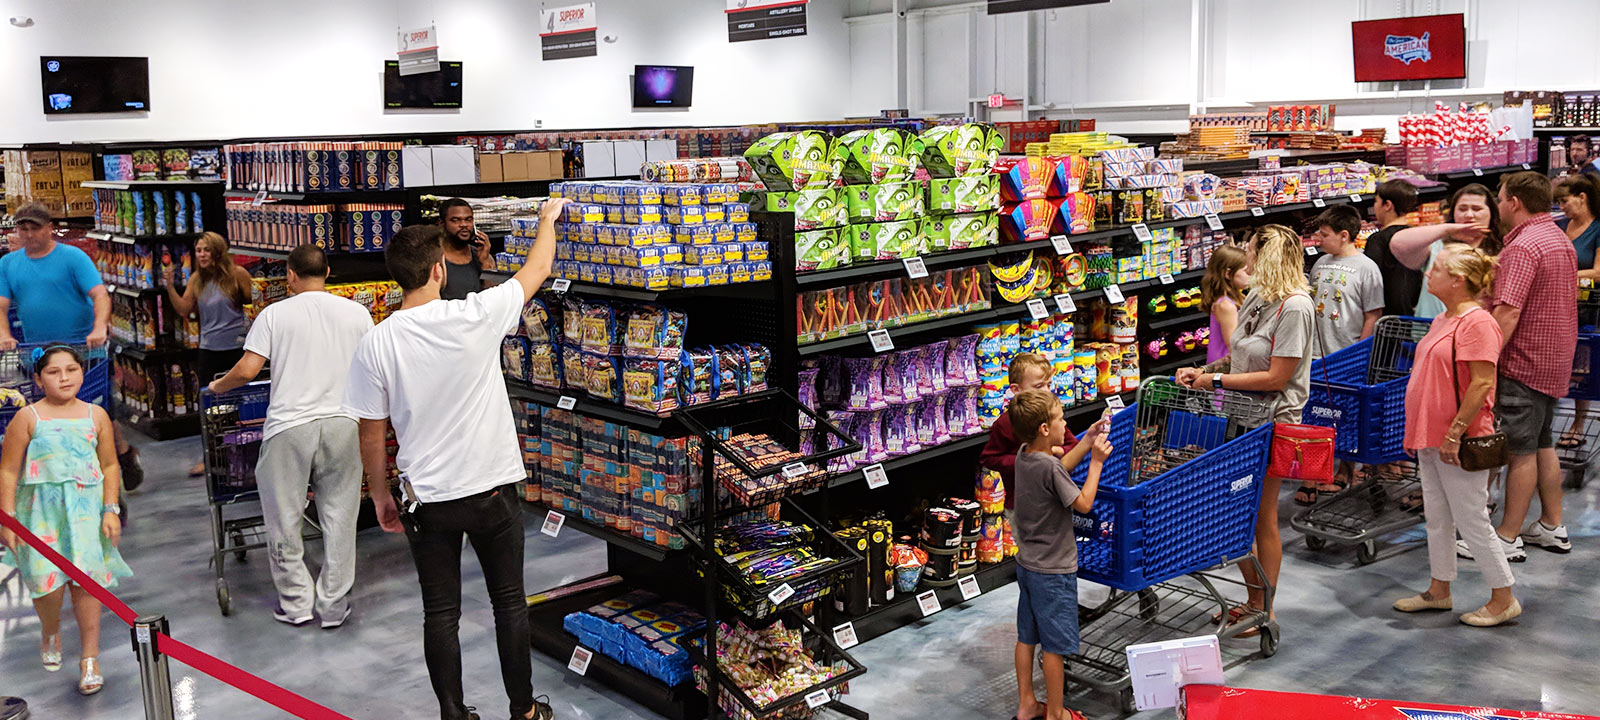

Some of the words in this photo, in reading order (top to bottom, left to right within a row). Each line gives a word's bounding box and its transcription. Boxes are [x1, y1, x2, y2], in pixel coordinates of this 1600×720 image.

[547, 12, 554, 33] 4
[559, 8, 584, 22] SUPERIOR
[403, 32, 408, 51] 5
[410, 30, 428, 42] SUPERIOR
[1385, 40, 1429, 54] AMERICAN
[868, 151, 910, 167] AMAZING
[952, 147, 989, 161] AMAZING
[789, 157, 834, 173] AMAZING
[1230, 474, 1253, 491] SUPERIOR
[1072, 515, 1094, 529] ERIOR
